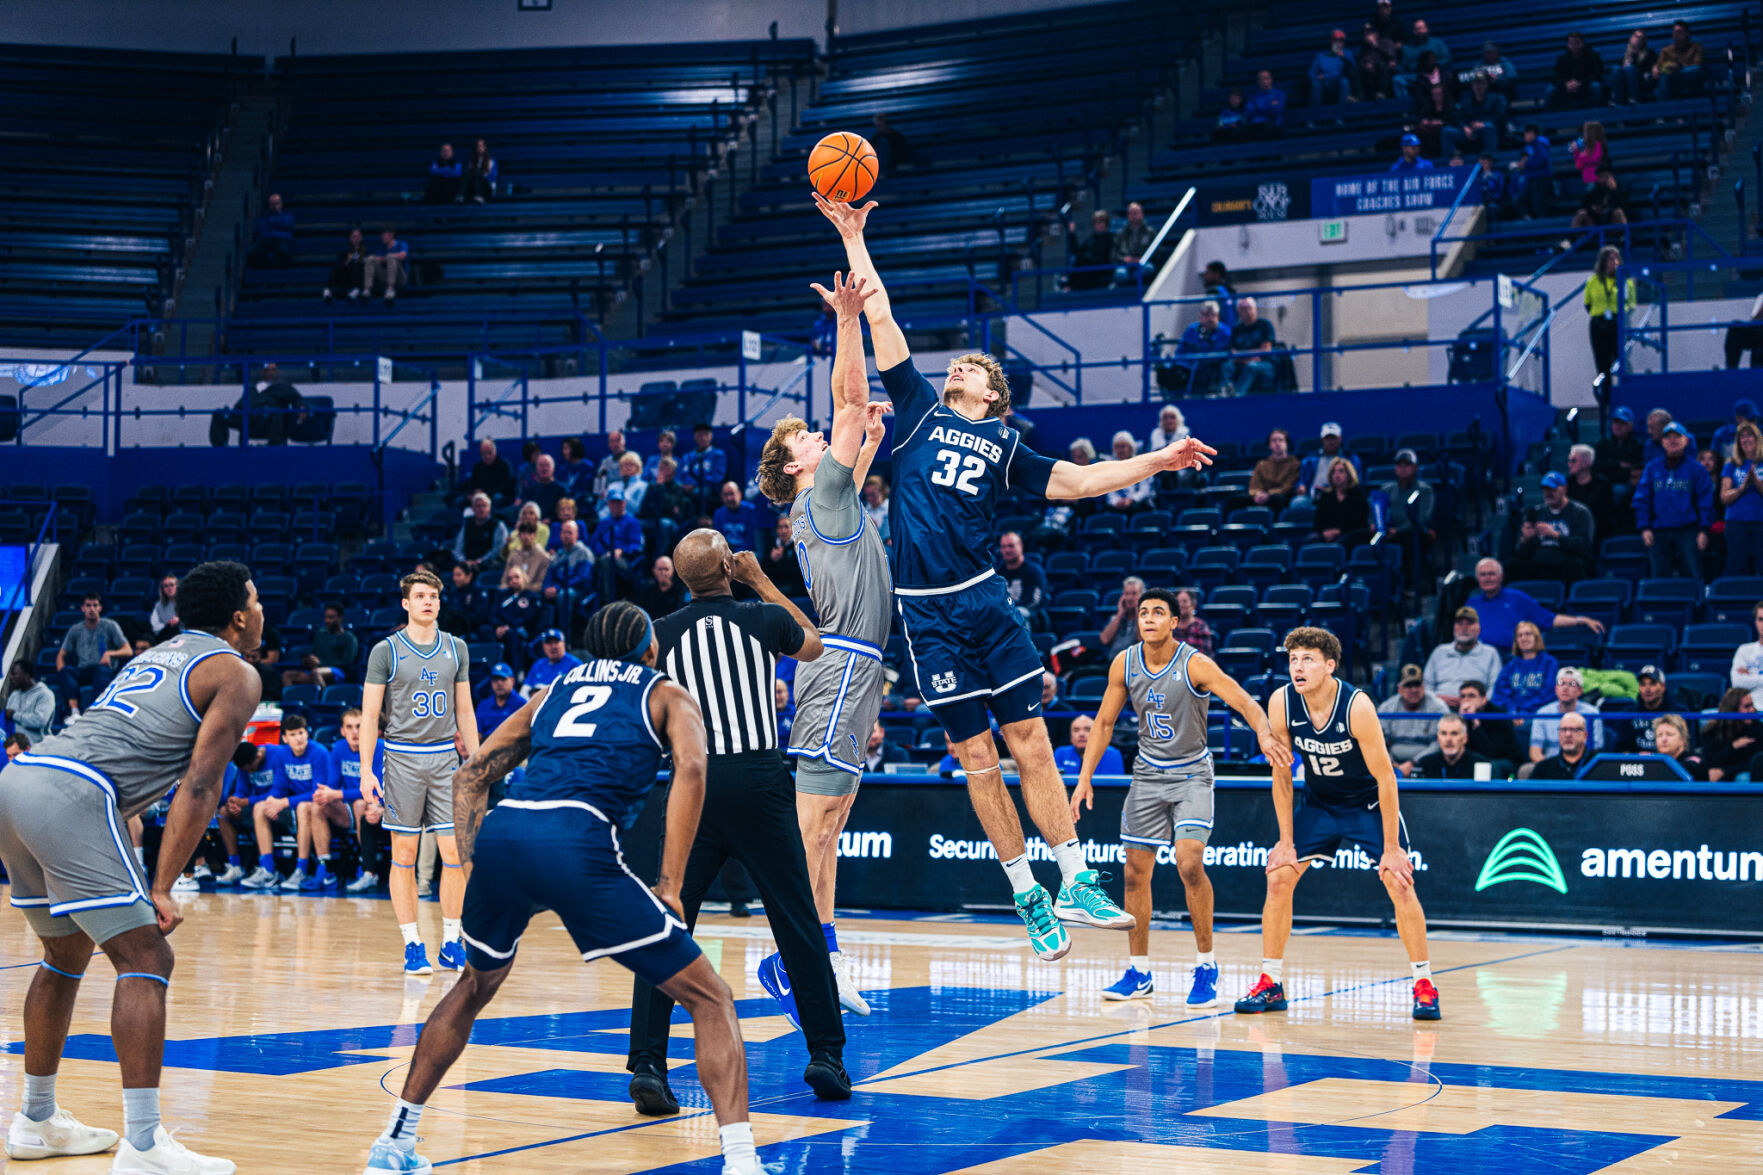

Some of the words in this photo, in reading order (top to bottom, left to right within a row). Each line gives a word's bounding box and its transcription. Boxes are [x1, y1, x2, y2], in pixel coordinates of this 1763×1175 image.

[1423, 174, 1454, 190] FORCE
[928, 426, 1003, 464] AGGIES
[931, 449, 986, 496] 32
[420, 666, 438, 686] AF
[412, 689, 447, 718] 30
[1146, 687, 1165, 709] AF
[552, 685, 612, 737] 2
[1145, 711, 1175, 739] 15
[1295, 736, 1353, 755] AGGIES
[1308, 754, 1344, 776] 12
